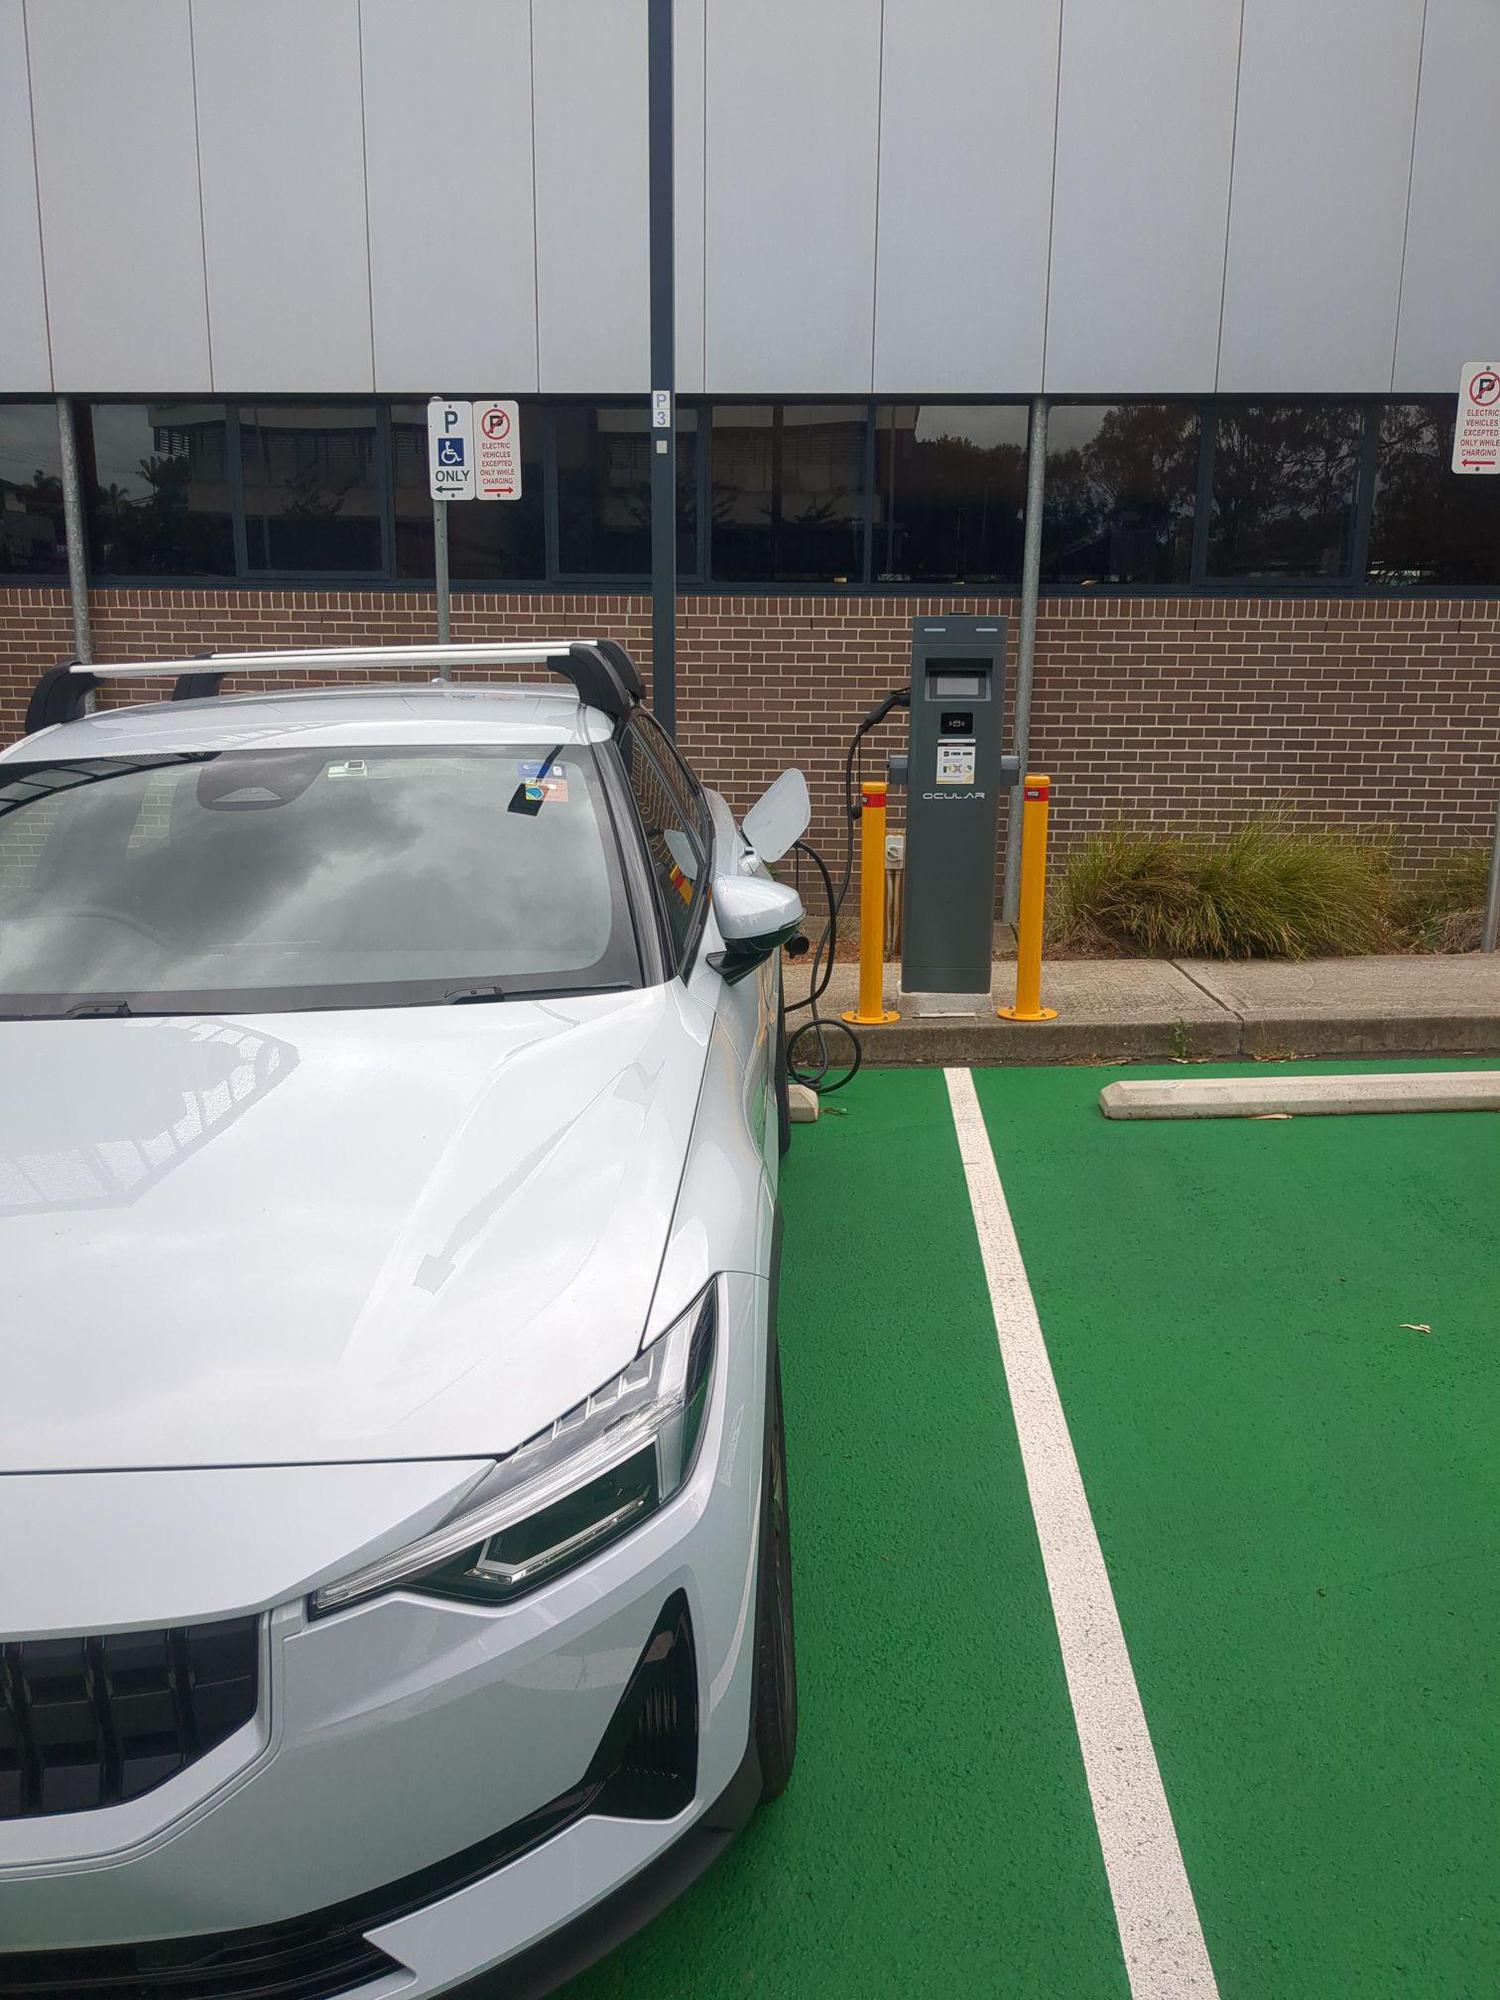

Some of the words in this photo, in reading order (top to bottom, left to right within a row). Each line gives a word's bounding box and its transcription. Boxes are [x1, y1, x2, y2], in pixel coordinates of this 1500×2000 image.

[1479, 379, 1496, 399] P
[656, 393, 667, 408] P
[657, 411, 666, 425] 3
[1466, 409, 1500, 417] ELECTRIC
[444, 411, 458, 433] P
[489, 415, 503, 433] P
[1465, 419, 1499, 427] VEHICLES
[1463, 429, 1499, 437] EXCEPTED
[1460, 439, 1477, 447] ONLY
[1479, 439, 1500, 447] WHILE
[1461, 449, 1497, 457] CHARGING
[435, 470, 470, 482] ONLY
[922, 792, 985, 800] OCULAR
